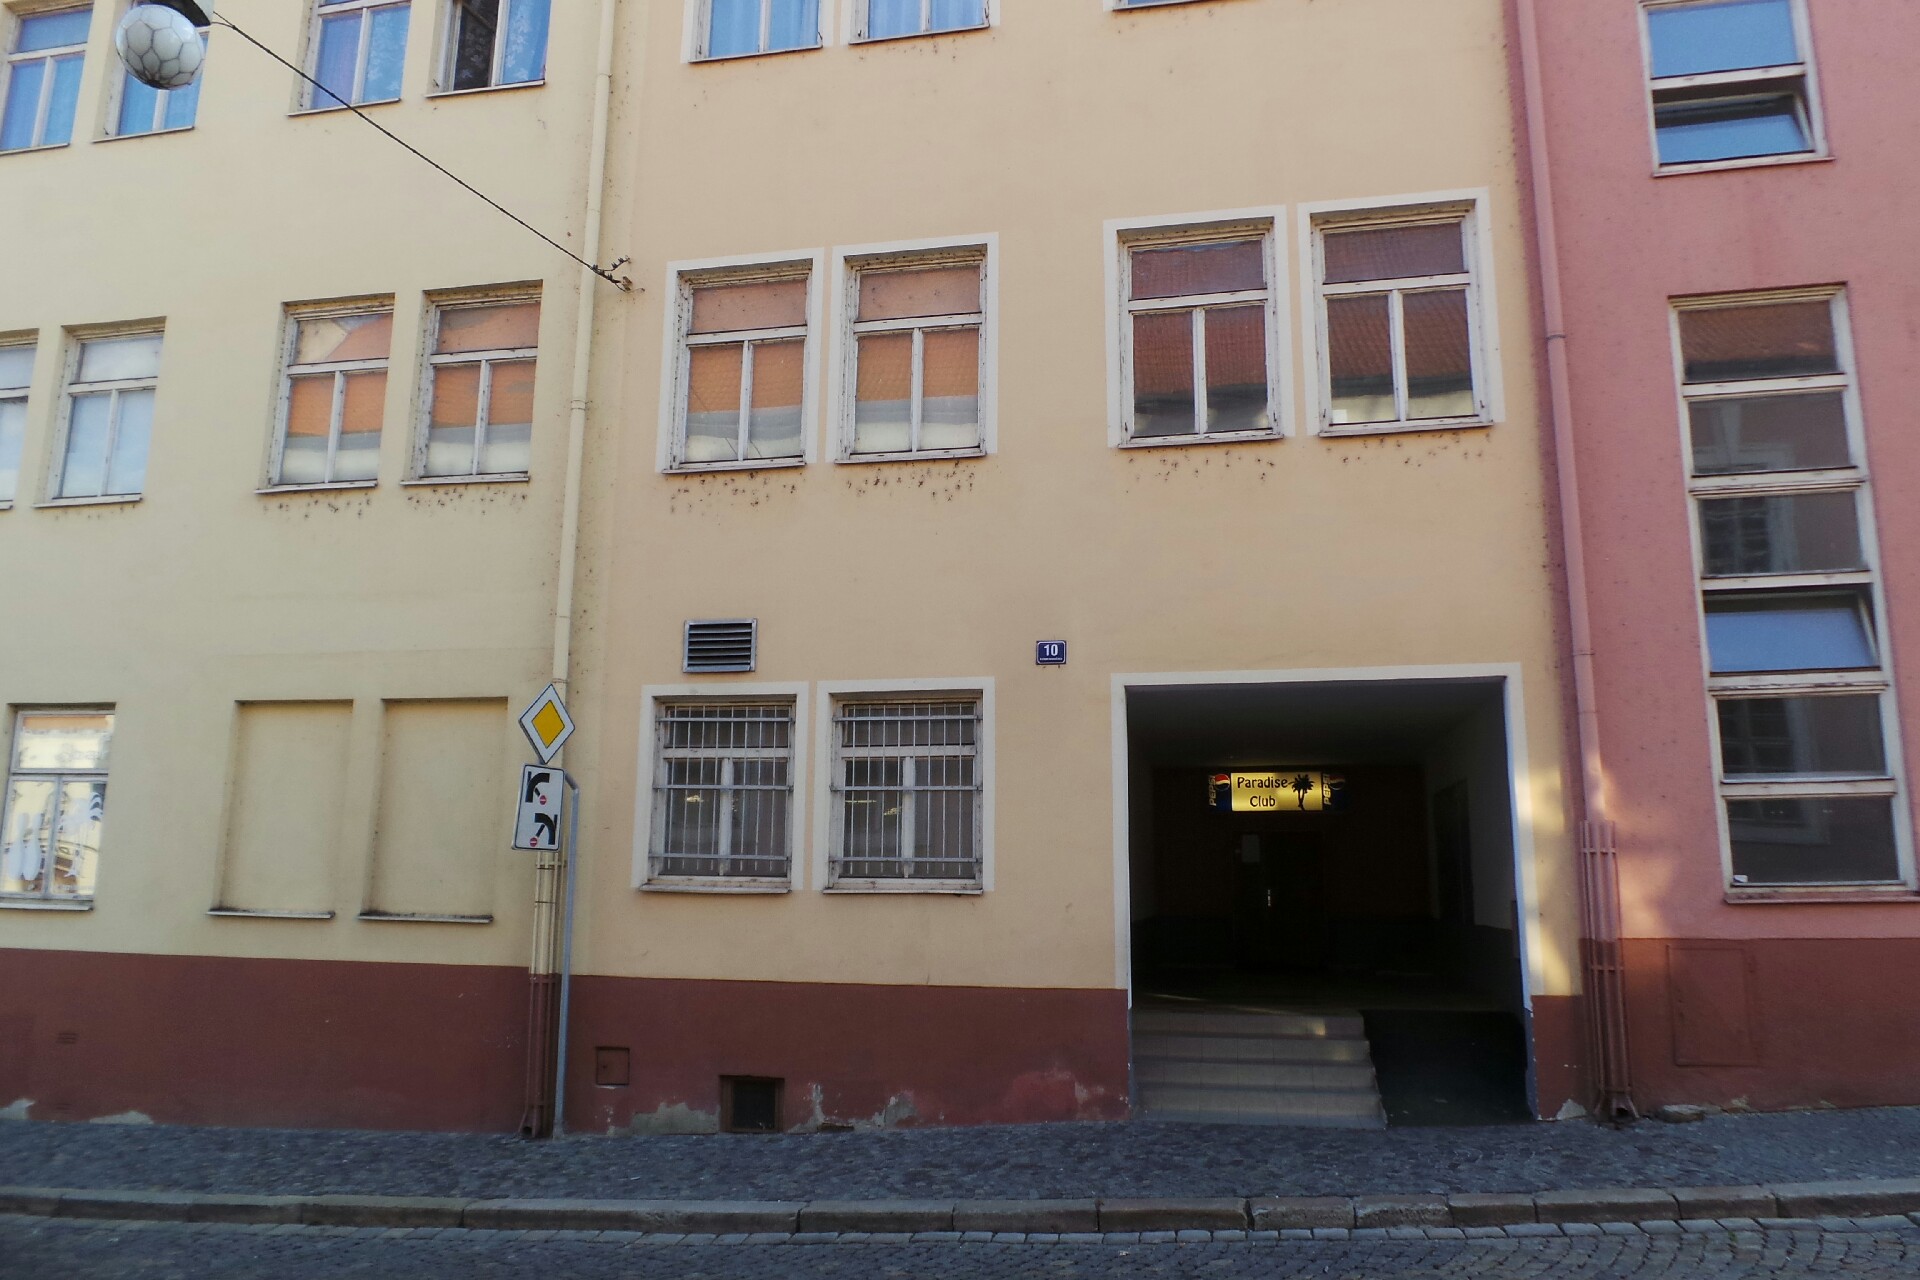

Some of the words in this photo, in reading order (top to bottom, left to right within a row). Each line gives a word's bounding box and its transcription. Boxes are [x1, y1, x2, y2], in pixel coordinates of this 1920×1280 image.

[1043, 644, 1059, 657] 10
[1237, 776, 1289, 789] Paradise
[1249, 795, 1276, 808] Club
